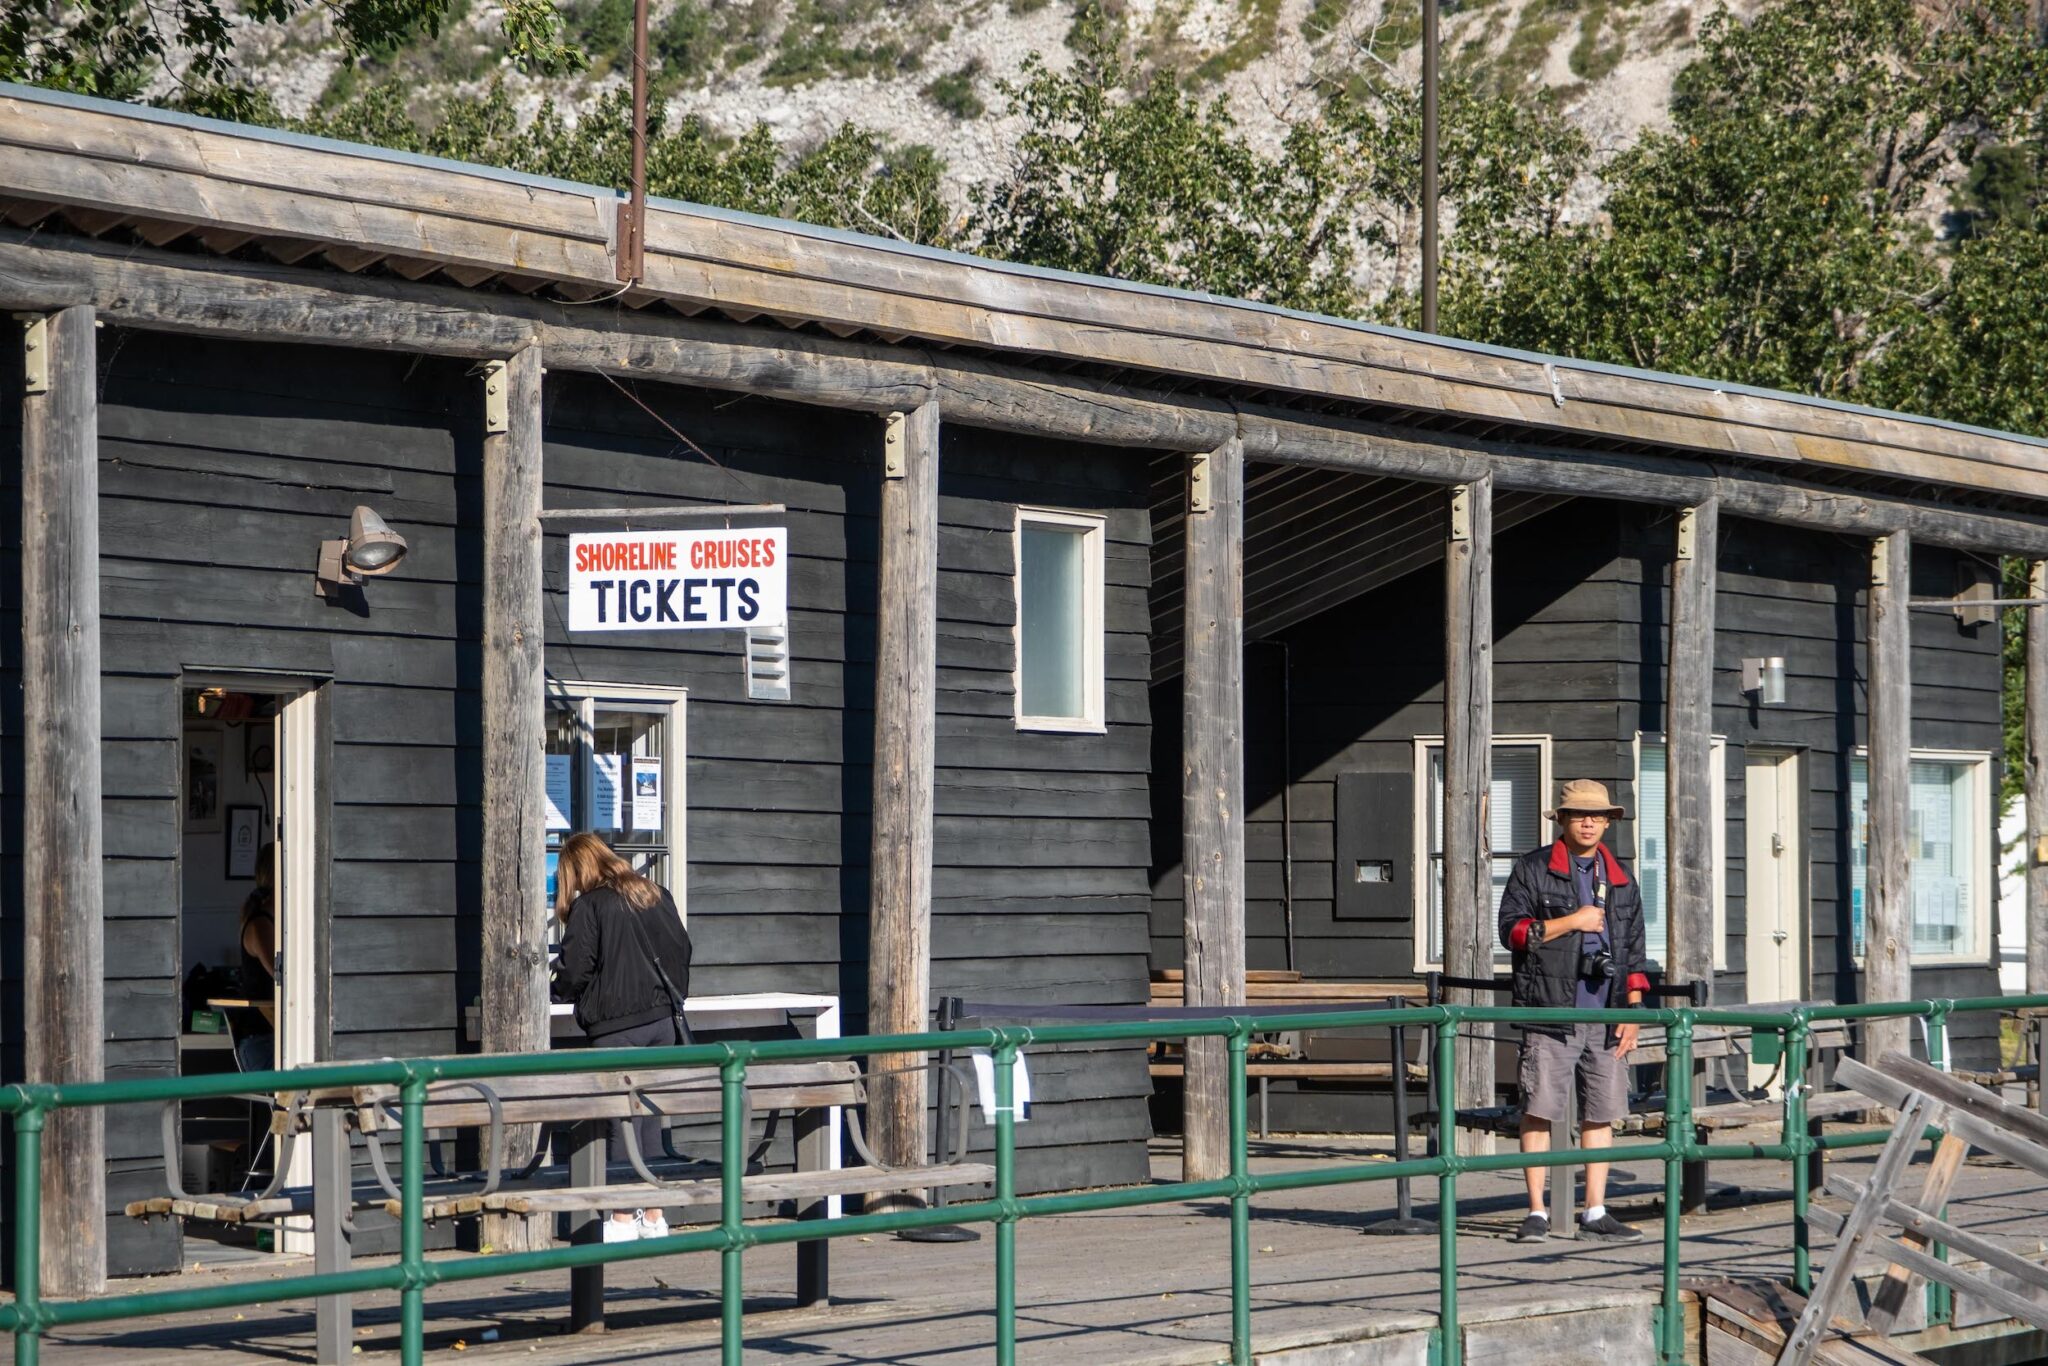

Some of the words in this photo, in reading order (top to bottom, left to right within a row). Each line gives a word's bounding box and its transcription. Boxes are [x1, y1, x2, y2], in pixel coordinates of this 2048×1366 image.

[575, 542, 677, 572] SHORELINE
[690, 538, 776, 570] CRUISES
[590, 577, 760, 623] TICKETS
